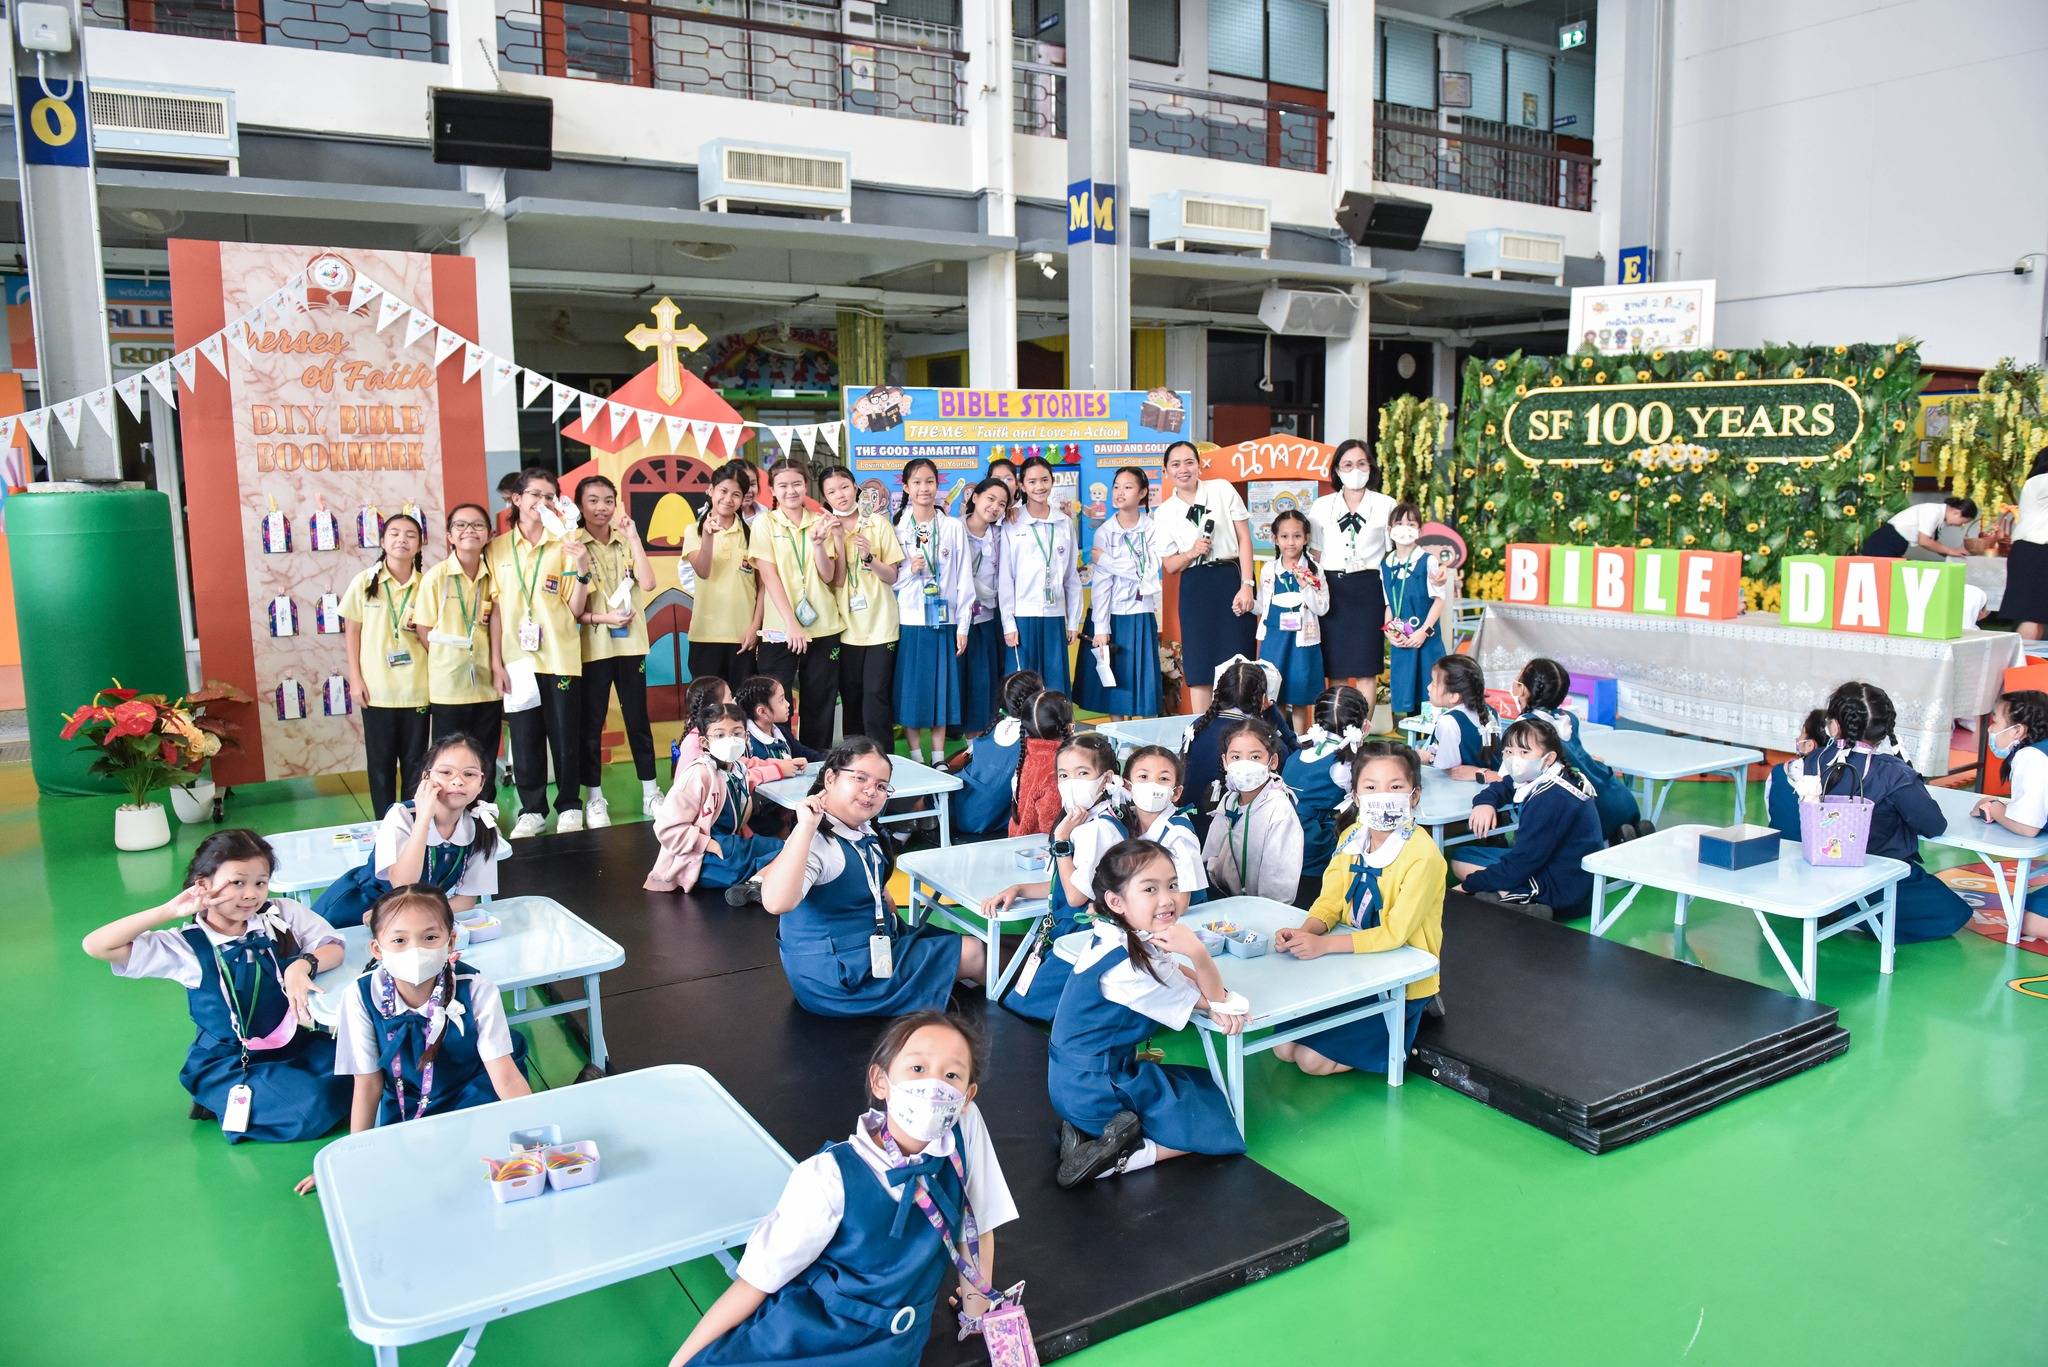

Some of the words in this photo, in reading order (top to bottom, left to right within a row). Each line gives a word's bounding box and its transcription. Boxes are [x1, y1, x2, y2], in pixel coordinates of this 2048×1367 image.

[1069, 191, 1089, 231] M
[1094, 197, 1114, 231] M
[1623, 255, 1642, 283] E
[119, 288, 165, 298] WELCOME
[301, 358, 337, 393] of
[340, 360, 437, 392] Faith
[251, 404, 328, 436] D.I.Y.
[339, 405, 425, 435] BIBLE
[941, 391, 1009, 417] BIBLE
[1020, 393, 1107, 418] STORIES
[909, 425, 966, 438] THEME:
[1012, 425, 1036, 438] and
[1040, 426, 1066, 438] Love
[1069, 427, 1080, 438] in
[1528, 409, 1573, 441] SF
[1583, 401, 1675, 446] 100
[1685, 402, 1836, 438] YEARS
[256, 441, 425, 473] BOOKMARK
[855, 446, 877, 456] THE
[879, 445, 910, 456] GOOD
[912, 445, 976, 456] SAMARITAN
[1094, 444, 1123, 453] DAVID
[1125, 444, 1143, 453] AND
[1508, 548, 1714, 616] BIBLE
[1788, 561, 1941, 634] DAY
